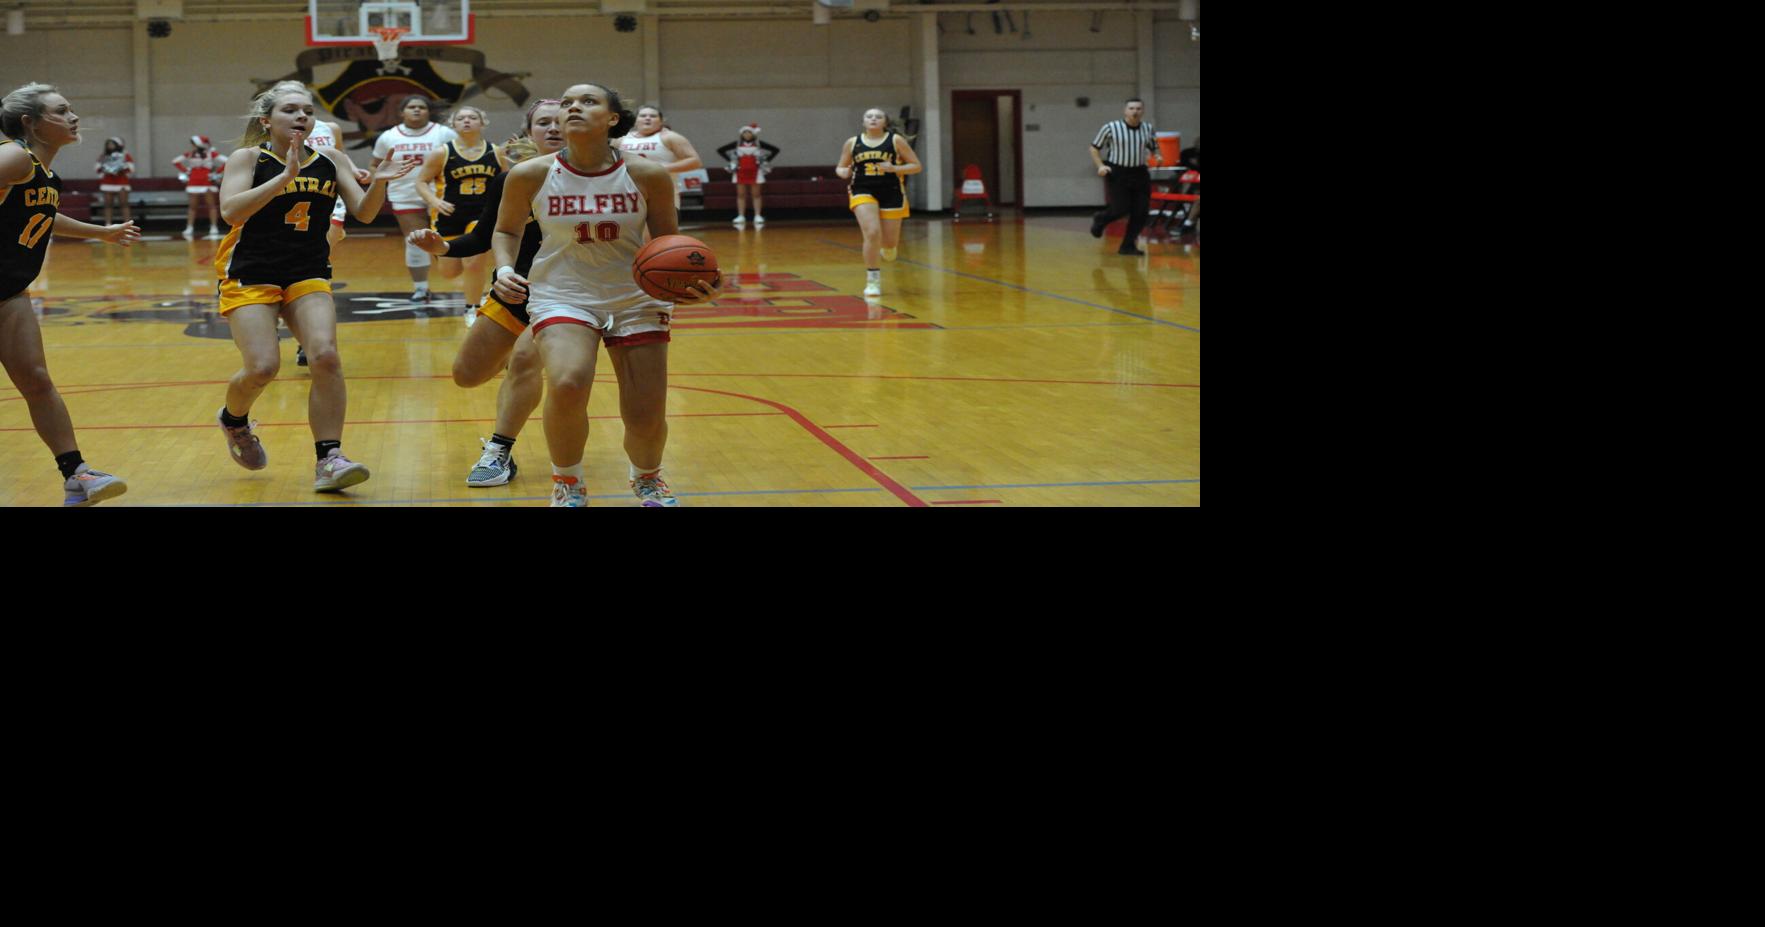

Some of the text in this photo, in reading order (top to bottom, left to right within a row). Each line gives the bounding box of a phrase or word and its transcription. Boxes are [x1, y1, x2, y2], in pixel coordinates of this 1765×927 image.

[450, 164, 496, 180] CENTRAL
[459, 177, 488, 195] 25
[548, 192, 639, 216] BELFRY
[284, 201, 311, 231] 4
[18, 212, 54, 249] 11
[574, 221, 620, 244] 10
